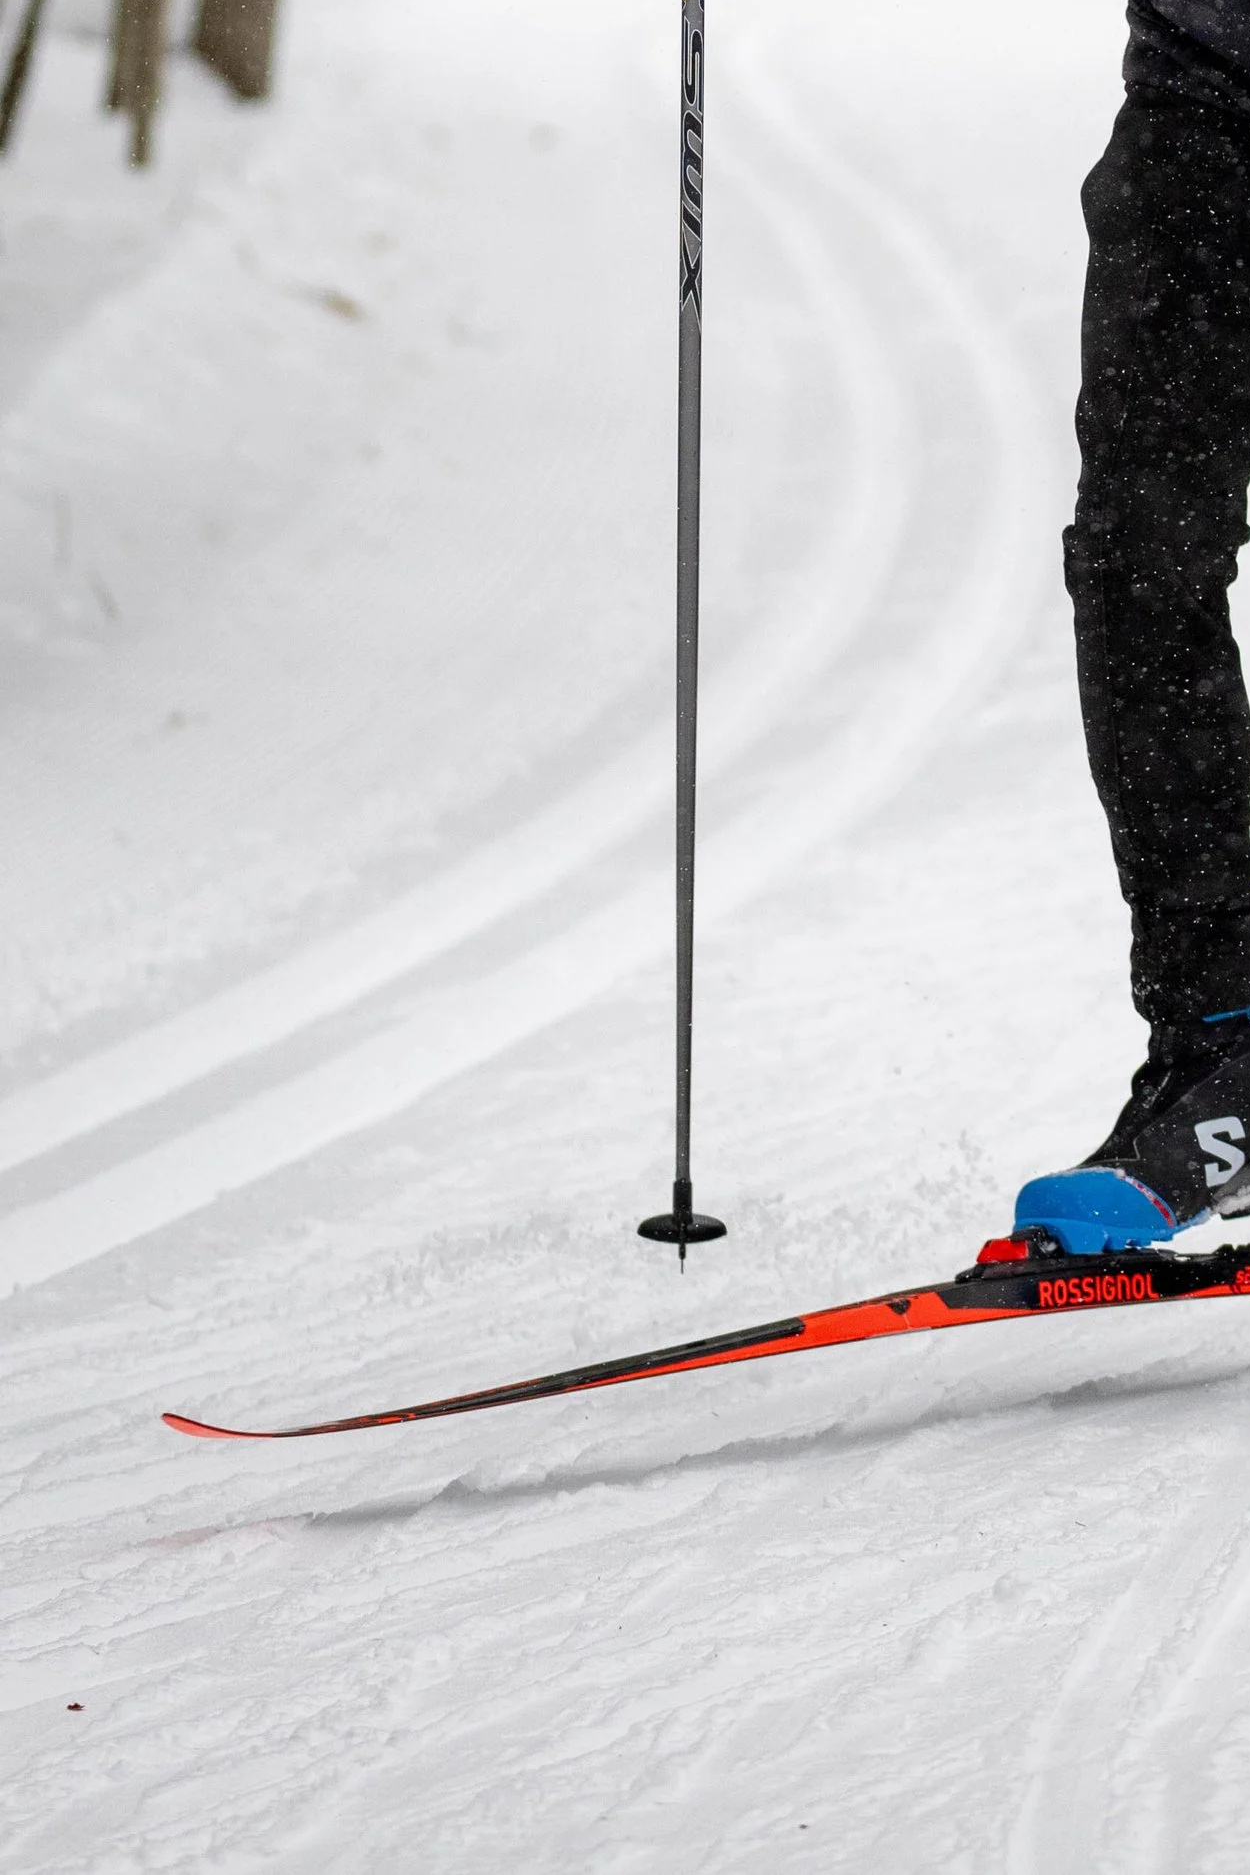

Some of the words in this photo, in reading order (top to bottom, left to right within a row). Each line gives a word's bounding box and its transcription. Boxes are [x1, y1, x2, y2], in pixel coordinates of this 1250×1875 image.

[681, 15, 703, 333] SWIX
[1194, 1116, 1246, 1188] S
[1038, 1272, 1160, 1308] ROSSIGNOL
